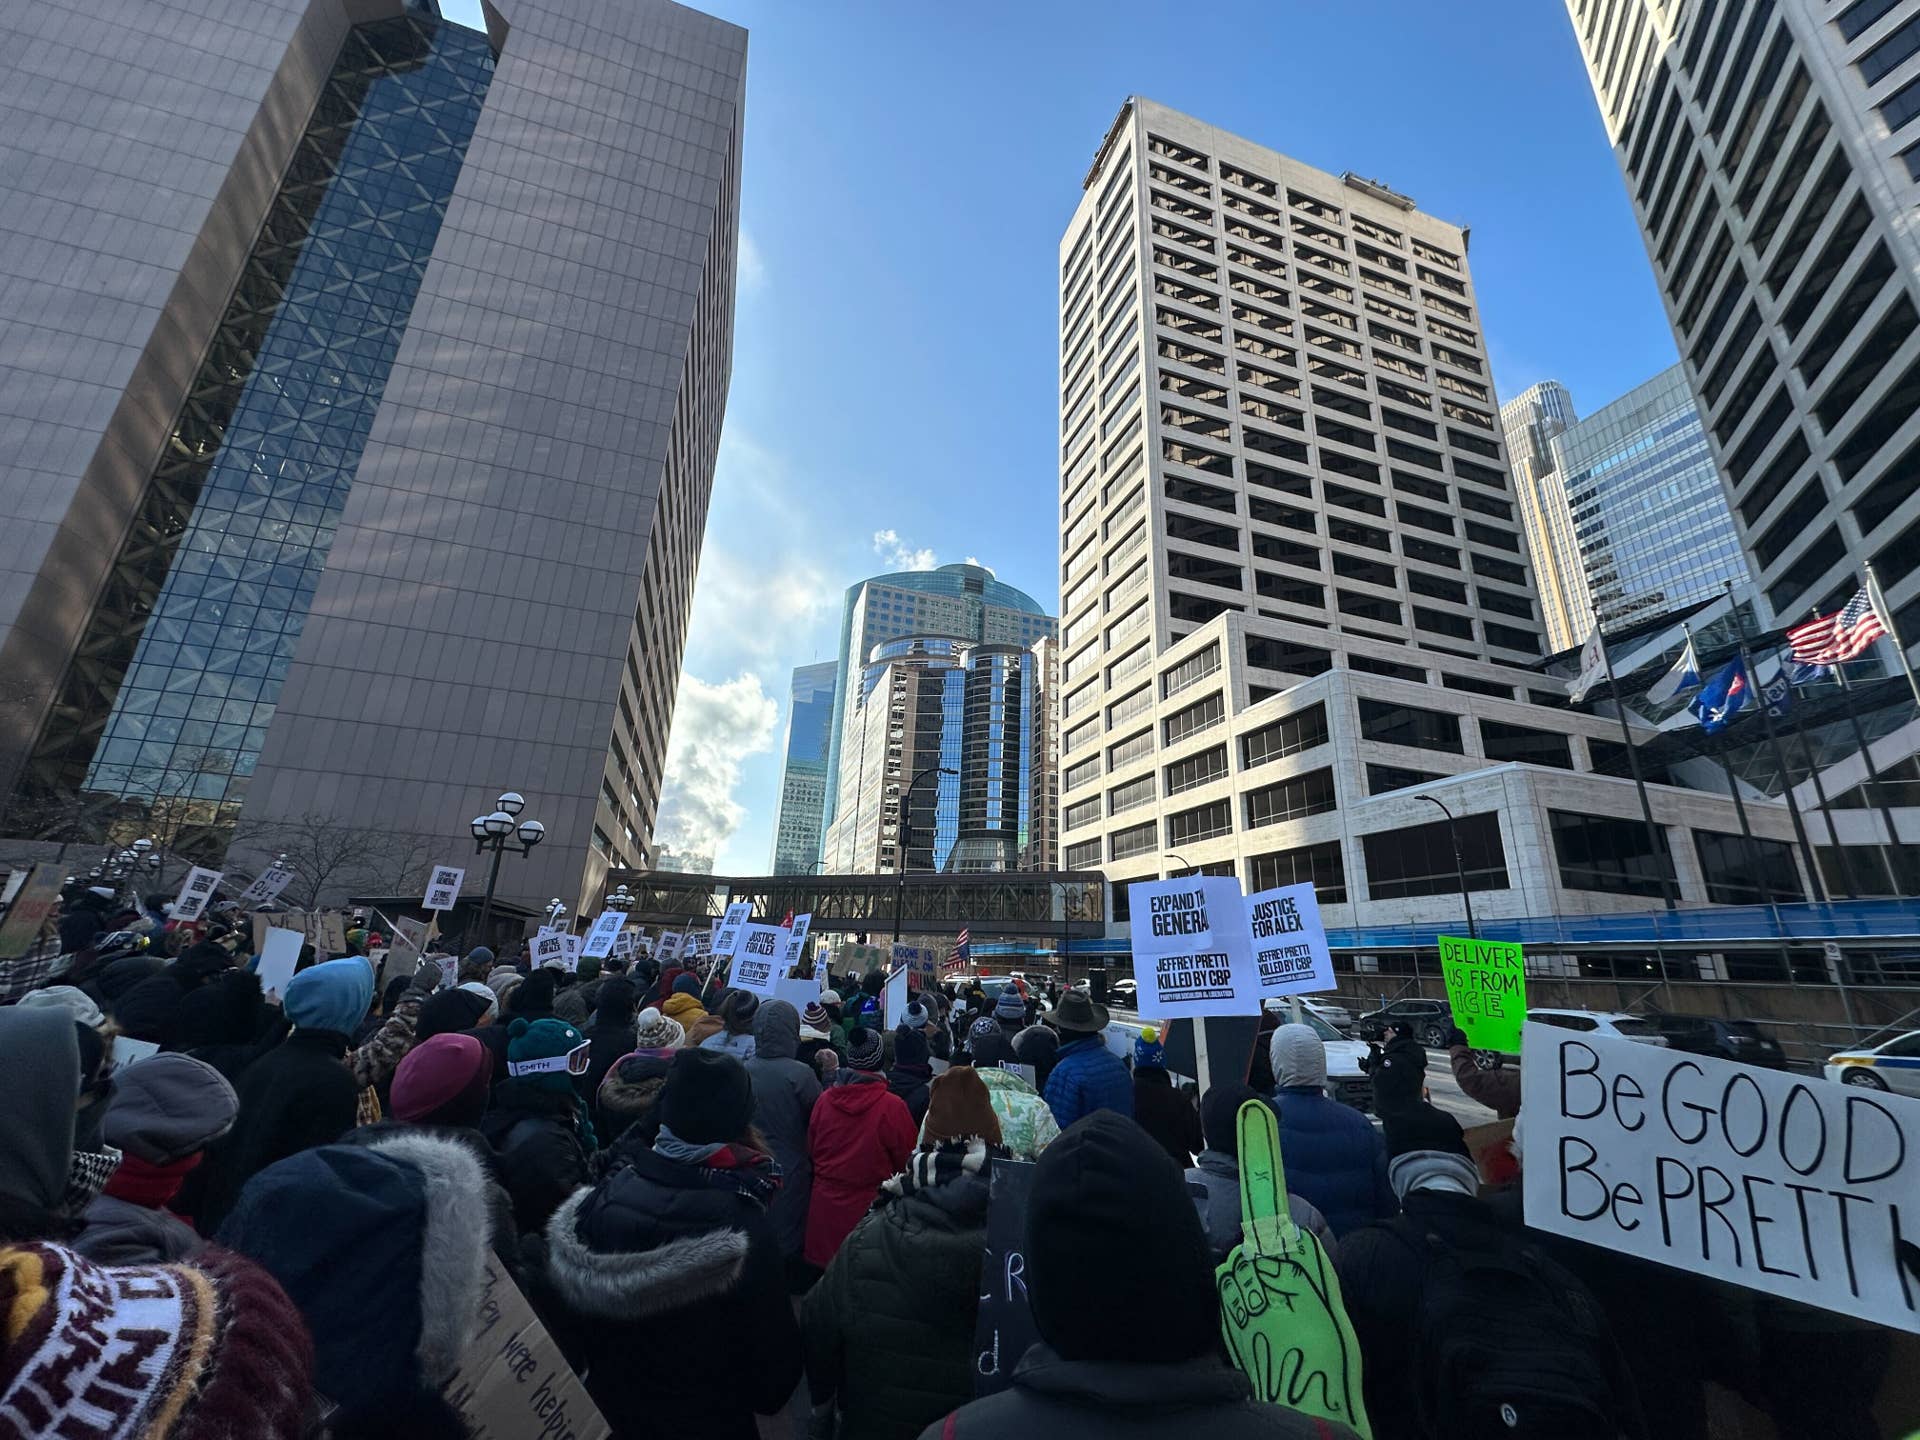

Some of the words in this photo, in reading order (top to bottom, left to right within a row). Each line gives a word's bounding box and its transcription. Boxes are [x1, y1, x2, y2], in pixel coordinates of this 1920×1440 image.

[265, 870, 287, 884] ICE
[250, 880, 275, 901] OUT
[1150, 892, 1195, 913] EXPAND
[1195, 888, 1206, 908] TH
[1151, 907, 1210, 937] GENERA
[1252, 897, 1298, 922] JUSTICE
[749, 931, 776, 945] JUSTICE
[1251, 920, 1274, 939] FOR
[1275, 914, 1304, 935] ALEX
[745, 942, 758, 954] FOR
[757, 943, 775, 956] ALEX
[1257, 947, 1284, 963] JEFFREY
[1285, 944, 1310, 958] PRETTI
[1444, 942, 1520, 969] DELIVER
[1156, 955, 1195, 972] JEFFREY
[1195, 953, 1230, 969] PRETTI
[1258, 960, 1284, 977] KILLED
[1284, 959, 1295, 974] BY
[1295, 956, 1312, 971] CBP
[1156, 971, 1192, 990] KILLED
[1192, 970, 1208, 987] BY
[1208, 969, 1231, 986] CBP
[1447, 968, 1464, 988] US
[1470, 969, 1520, 997] FROM
[1455, 990, 1505, 1019] ICE
[520, 1061, 551, 1073] SMITH
[1559, 1040, 1646, 1132] Be
[1662, 1060, 1906, 1186] GOOD
[1559, 1136, 1644, 1231] Be
[502, 1332, 538, 1384] were
